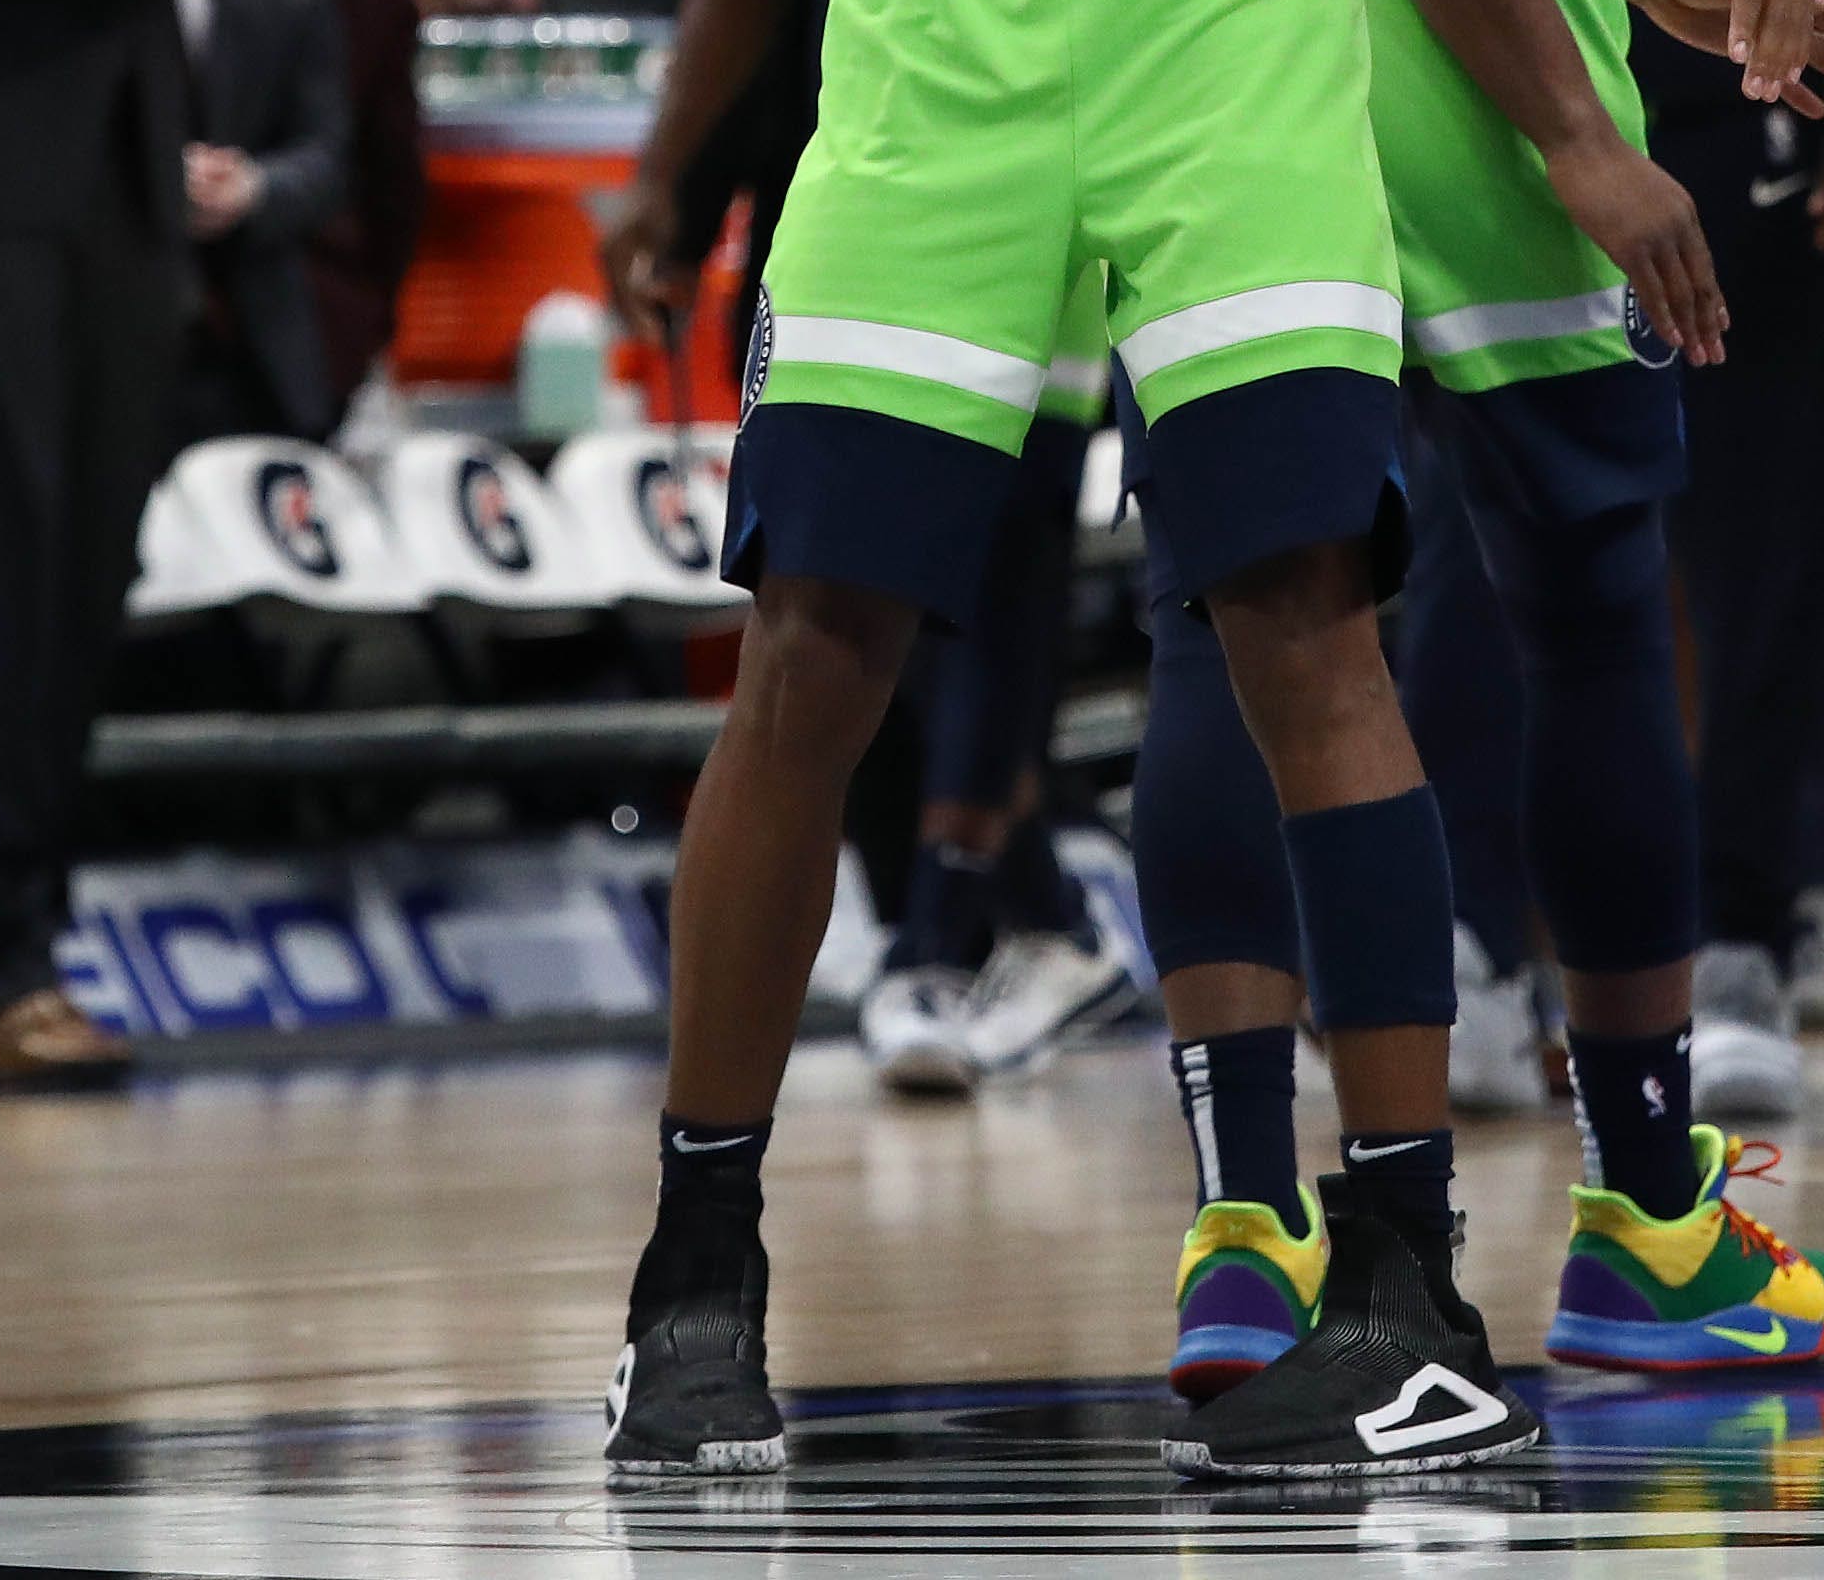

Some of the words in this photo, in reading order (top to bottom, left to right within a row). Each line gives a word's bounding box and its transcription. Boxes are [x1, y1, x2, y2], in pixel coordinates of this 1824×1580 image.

[256, 460, 339, 577] G
[457, 458, 531, 572] G
[636, 458, 712, 570] G
